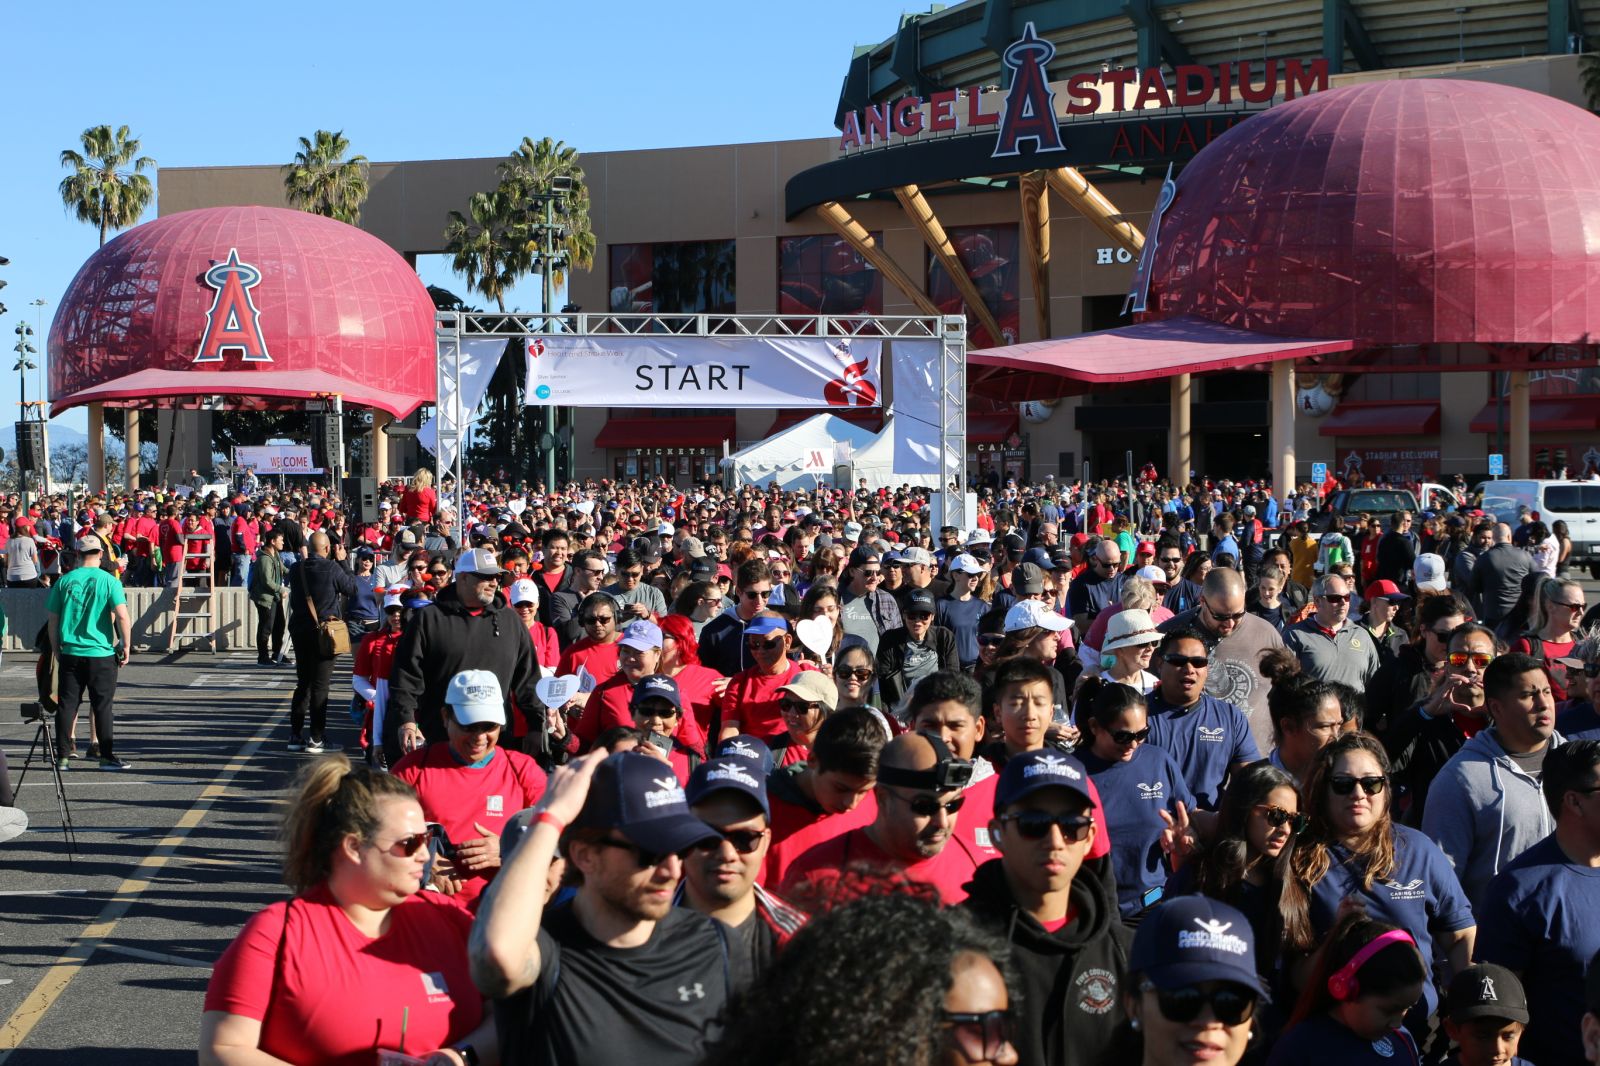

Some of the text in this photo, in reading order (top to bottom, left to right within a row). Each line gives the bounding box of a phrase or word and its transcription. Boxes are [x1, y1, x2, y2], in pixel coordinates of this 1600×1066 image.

[1066, 59, 1330, 115] STADIUM
[840, 86, 1000, 151] ANGEL
[635, 364, 750, 391] START
[270, 456, 308, 467] WELCOME
